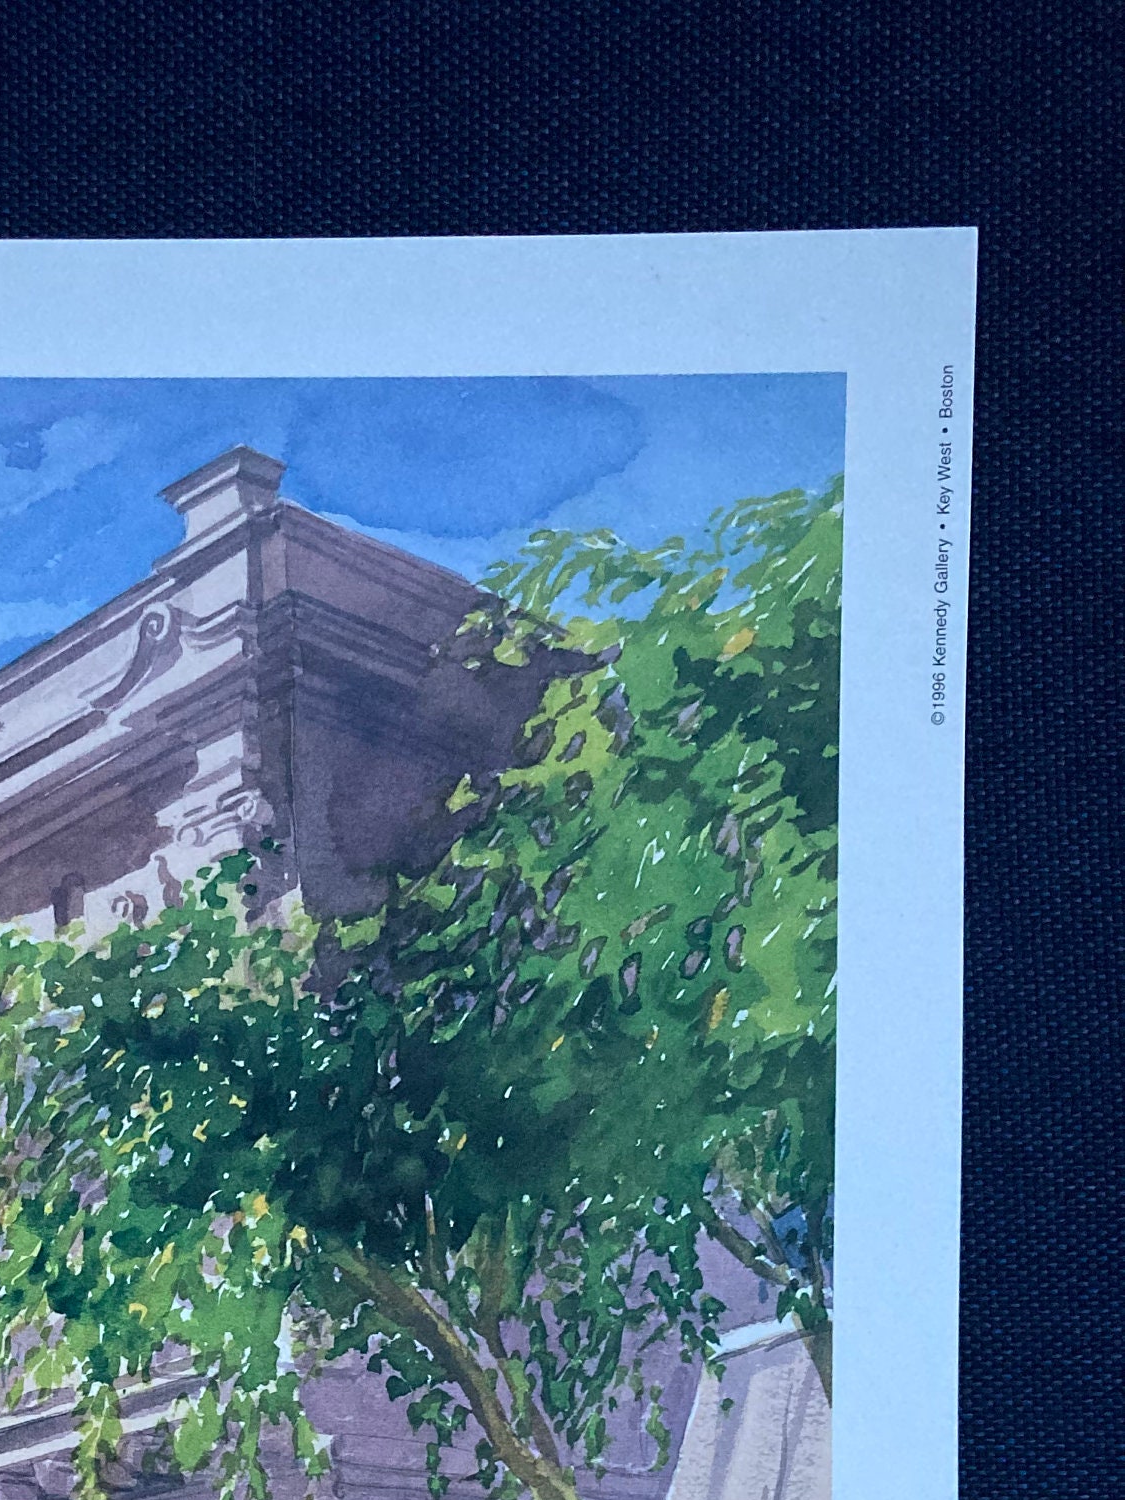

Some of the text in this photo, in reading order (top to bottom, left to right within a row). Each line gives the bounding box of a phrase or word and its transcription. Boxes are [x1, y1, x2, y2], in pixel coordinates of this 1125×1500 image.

[939, 365, 953, 418] Boston
[937, 442, 952, 481] West
[936, 486, 953, 514] Key
[934, 539, 953, 594] Gallery
[932, 600, 951, 667] Kennedy
